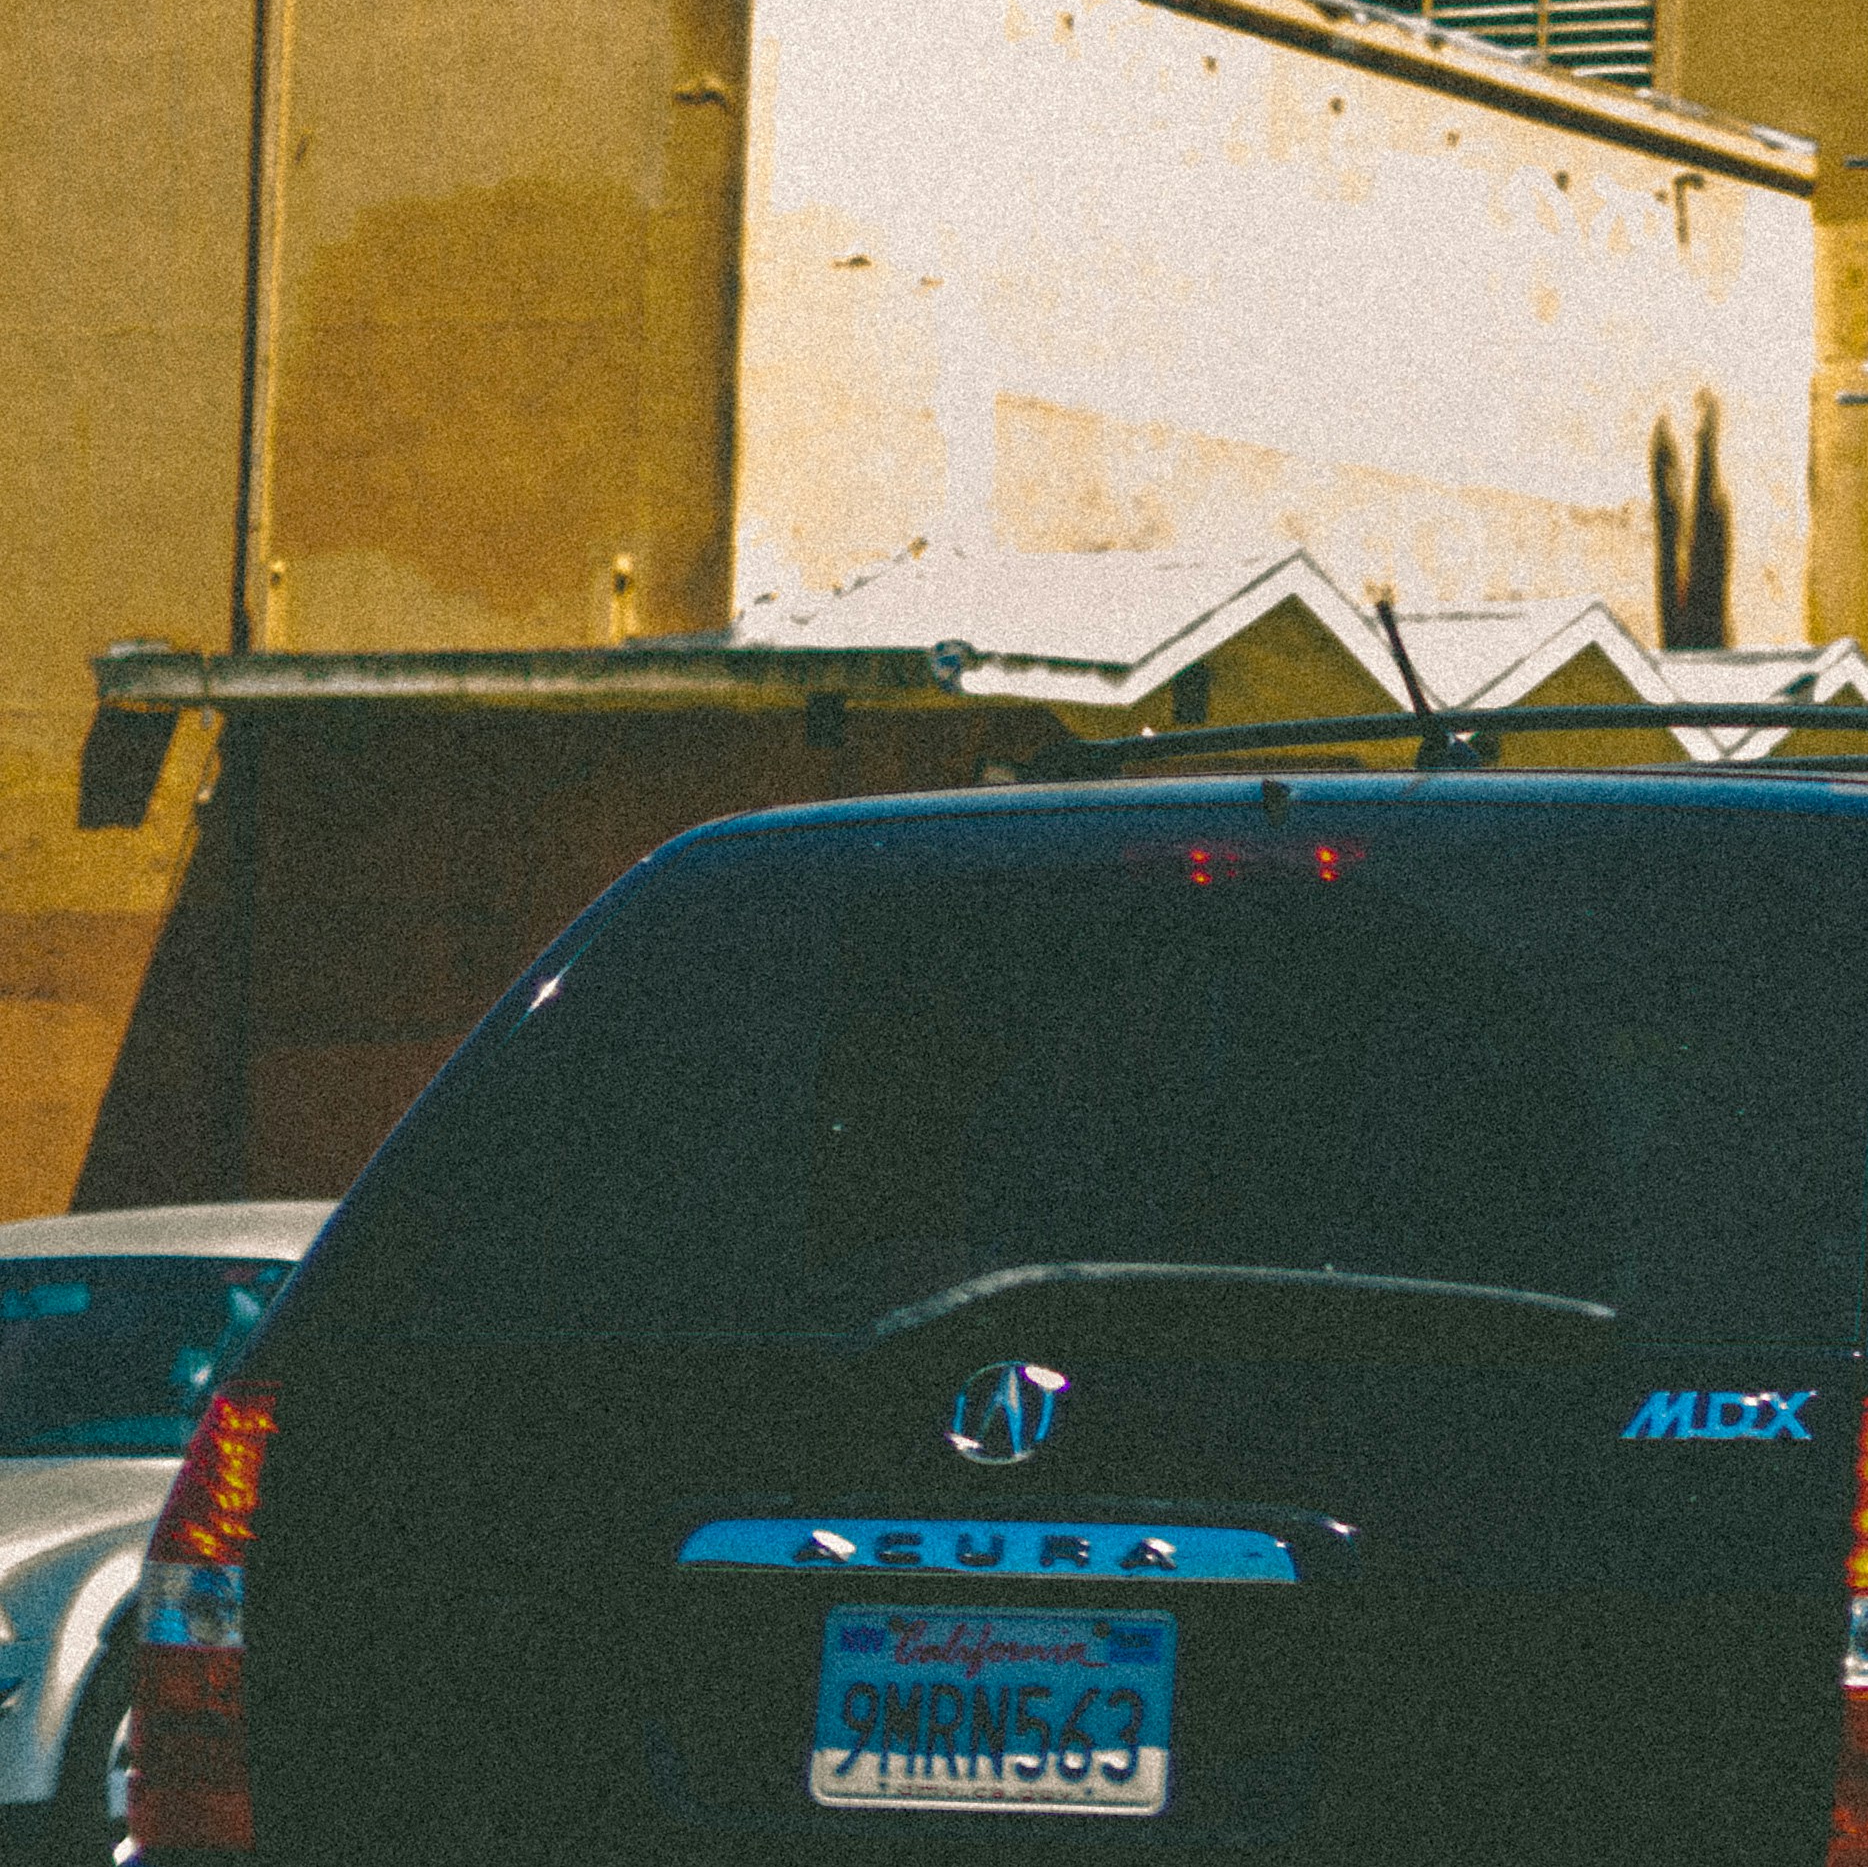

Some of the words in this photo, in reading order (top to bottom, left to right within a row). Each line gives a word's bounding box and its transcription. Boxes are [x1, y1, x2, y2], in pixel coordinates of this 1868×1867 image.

[1618, 1389, 1819, 1440] MDX
[794, 1529, 1177, 1570] ACURA
[893, 1618, 1109, 1680] California
[835, 1681, 1146, 1786] 9MRN563
